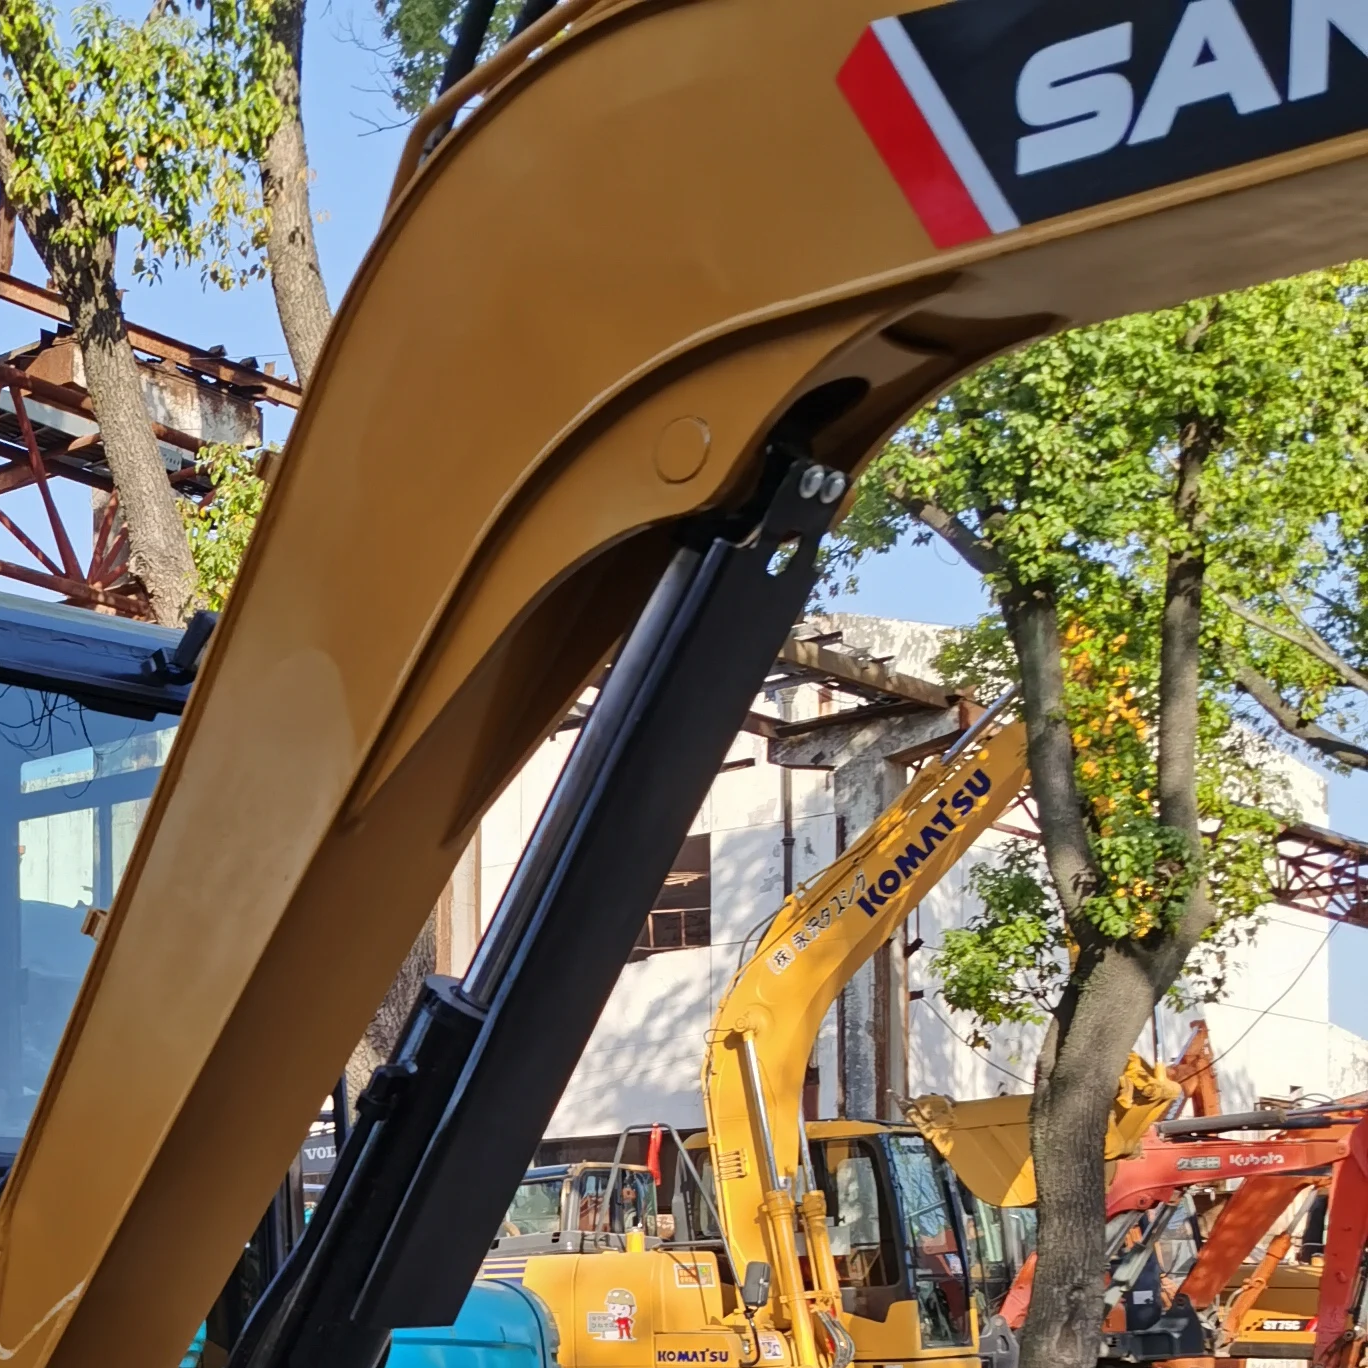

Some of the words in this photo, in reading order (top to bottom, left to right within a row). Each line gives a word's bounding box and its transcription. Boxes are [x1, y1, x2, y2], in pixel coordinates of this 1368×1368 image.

[857, 768, 992, 918] KOMATSU
[1229, 1151, 1285, 1167] Kubota
[657, 1348, 729, 1363] KOMATSU
